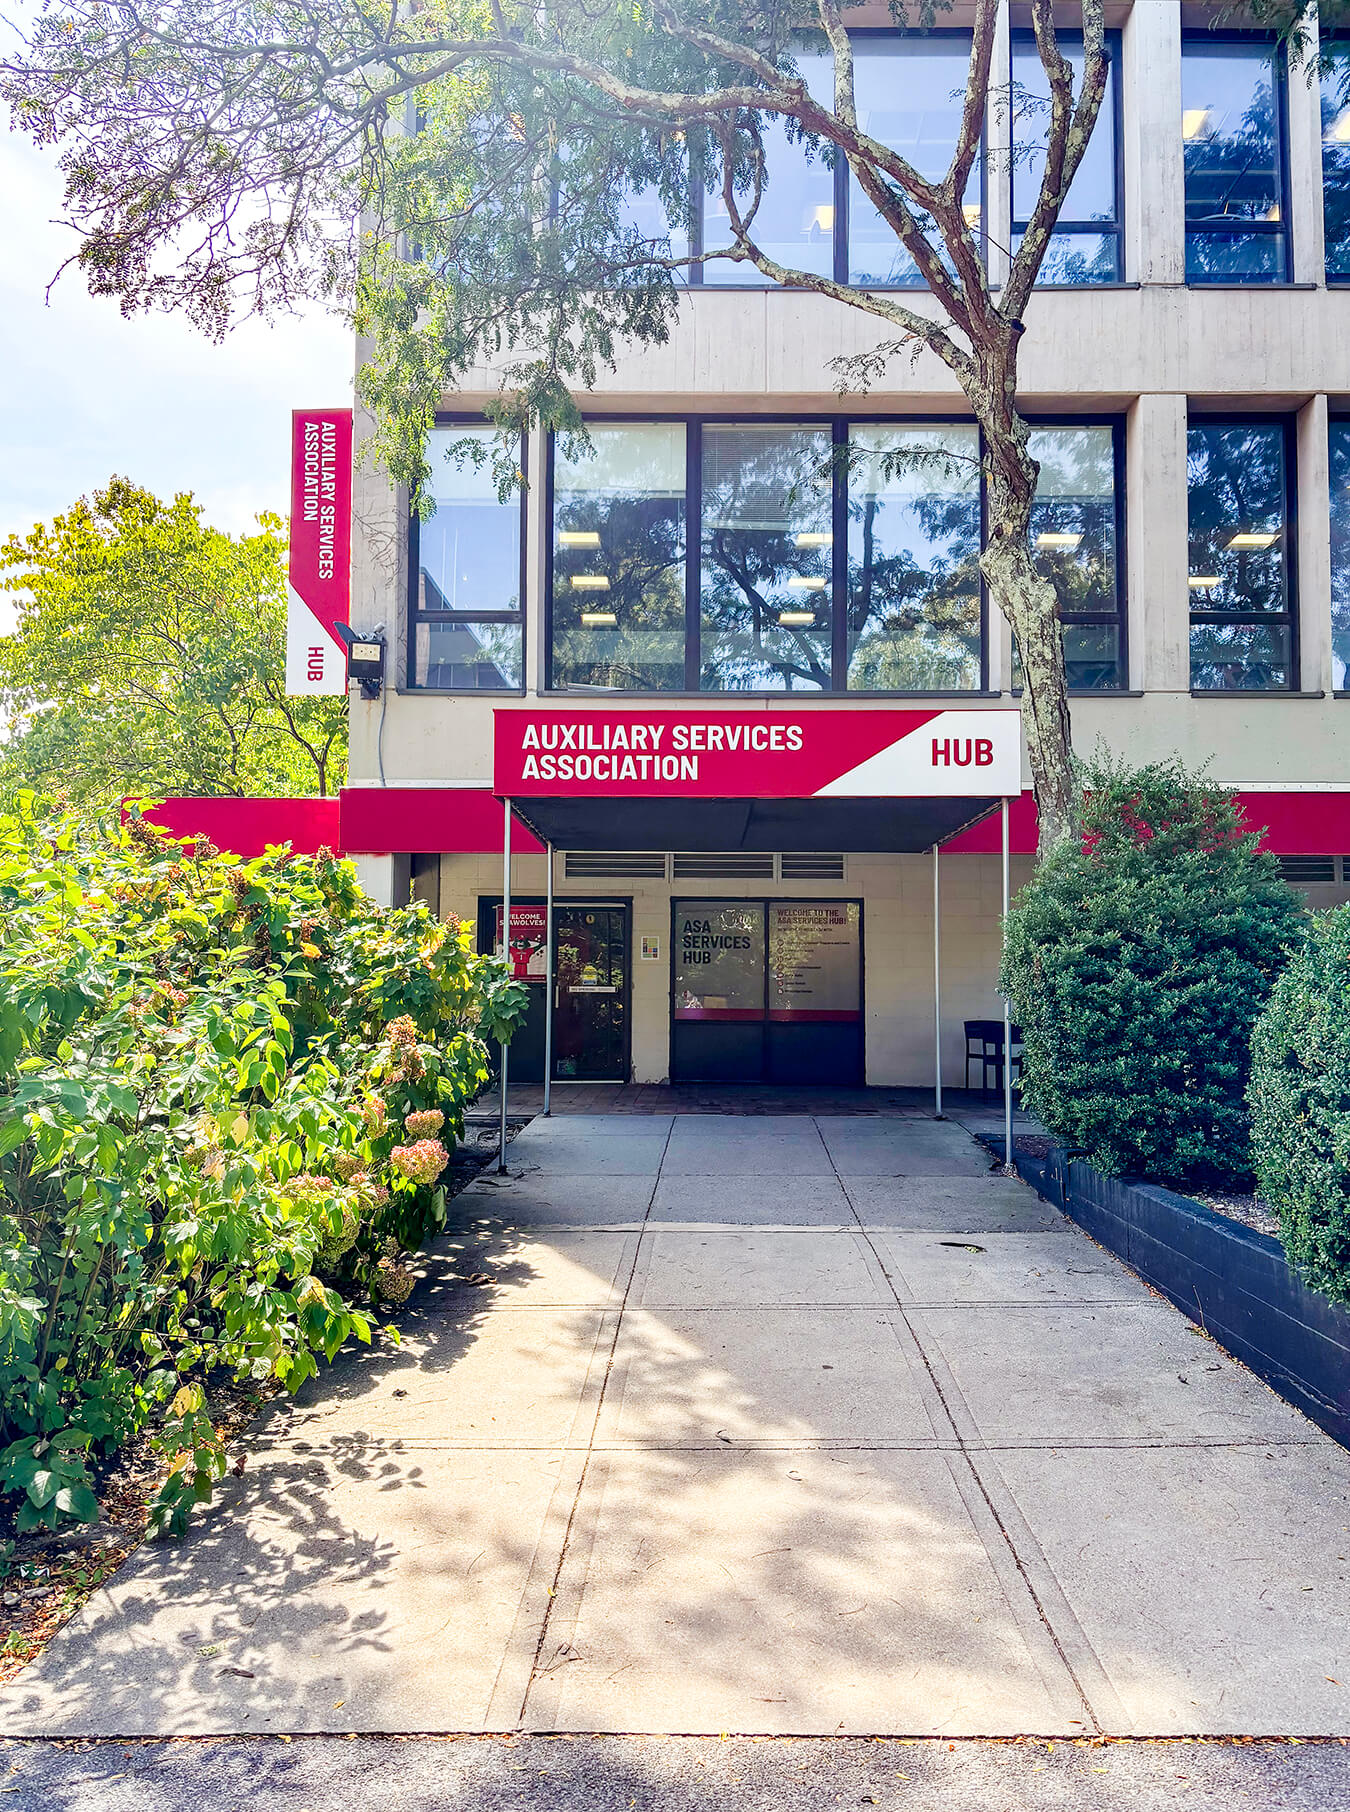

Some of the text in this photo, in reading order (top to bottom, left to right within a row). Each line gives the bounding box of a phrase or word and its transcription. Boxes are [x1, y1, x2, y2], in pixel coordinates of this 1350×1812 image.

[303, 422, 318, 521] ASSOCIATION
[318, 421, 336, 580] AUXILIARY SERVICES
[307, 647, 324, 681] HUB
[521, 724, 803, 751] AUXILIARY SERVICES
[931, 738, 994, 767] HUB
[521, 754, 699, 780] ASSOCIATION
[777, 909, 839, 917] WELCOME TO THE
[829, 917, 847, 925] HUB!
[683, 920, 711, 933] ASA
[683, 936, 751, 949] SERVICES
[683, 951, 711, 964] HUB
